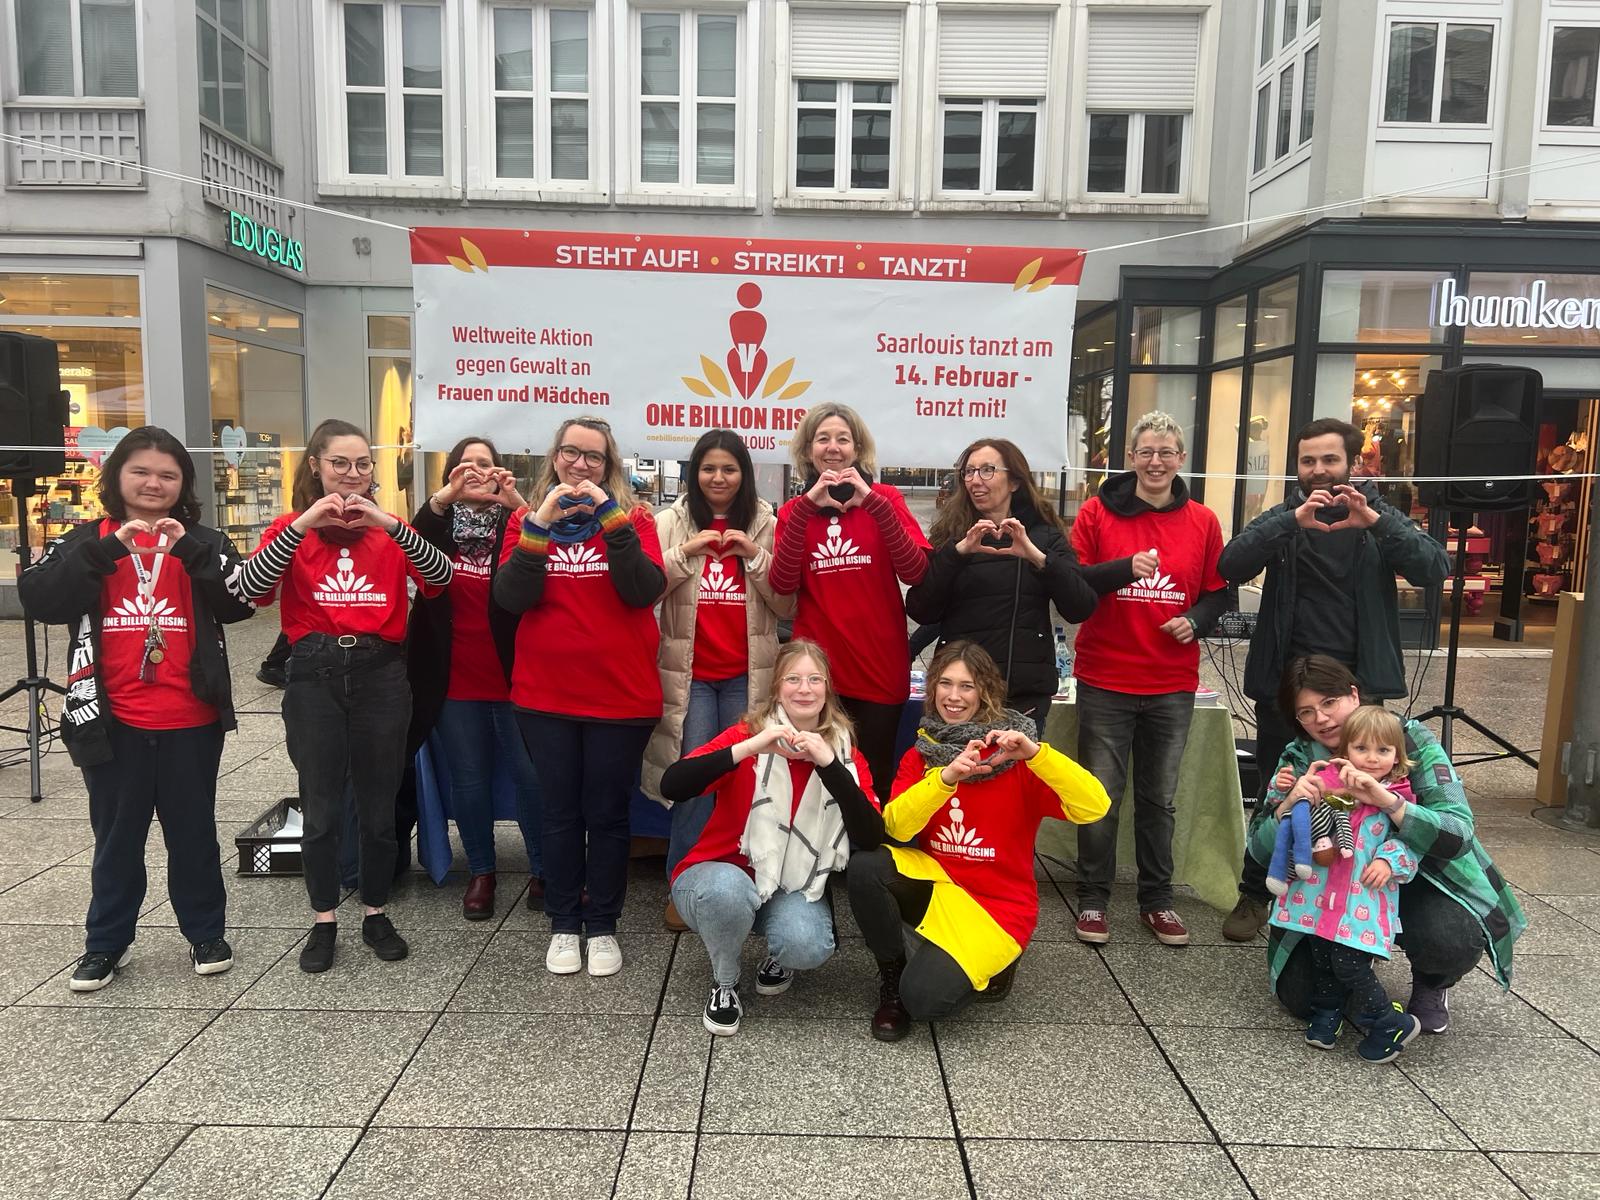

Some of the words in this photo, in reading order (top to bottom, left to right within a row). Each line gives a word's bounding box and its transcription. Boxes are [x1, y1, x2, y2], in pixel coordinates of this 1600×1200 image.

[230, 210, 303, 272] DOUGLAS
[352, 236, 371, 256] 13
[555, 244, 636, 266] STEHT
[641, 248, 699, 269] AUF!
[733, 251, 844, 275] STREIKT!
[879, 256, 967, 278] TANZT!
[452, 325, 536, 345] Weltweite
[540, 328, 593, 347] Aktion
[877, 332, 964, 355] Saarlouis
[969, 335, 1018, 357] tanzt
[1022, 340, 1053, 358] am
[456, 357, 506, 376] gegen
[510, 357, 567, 376] Gewalt
[571, 361, 591, 376] an
[895, 364, 928, 386] 14.
[934, 365, 1019, 388] Februar
[438, 384, 494, 403] Frauen
[497, 385, 529, 404] und
[533, 386, 610, 406] Mädchen
[646, 403, 685, 427] ONE
[689, 405, 767, 430] BILLION
[771, 407, 807, 431] RIS
[915, 396, 964, 417] tanzt
[968, 397, 1007, 418] mit!
[64, 437, 78, 445] SAL
[1247, 455, 1268, 472] SALE
[553, 562, 585, 573] BILLION
[586, 562, 609, 572] RISIN
[817, 556, 845, 569] BILLION
[845, 554, 872, 565] RISING
[325, 591, 357, 602] BILLION
[358, 592, 387, 602] RISING
[1132, 588, 1160, 599] BILLION
[1160, 590, 1186, 601] RISING
